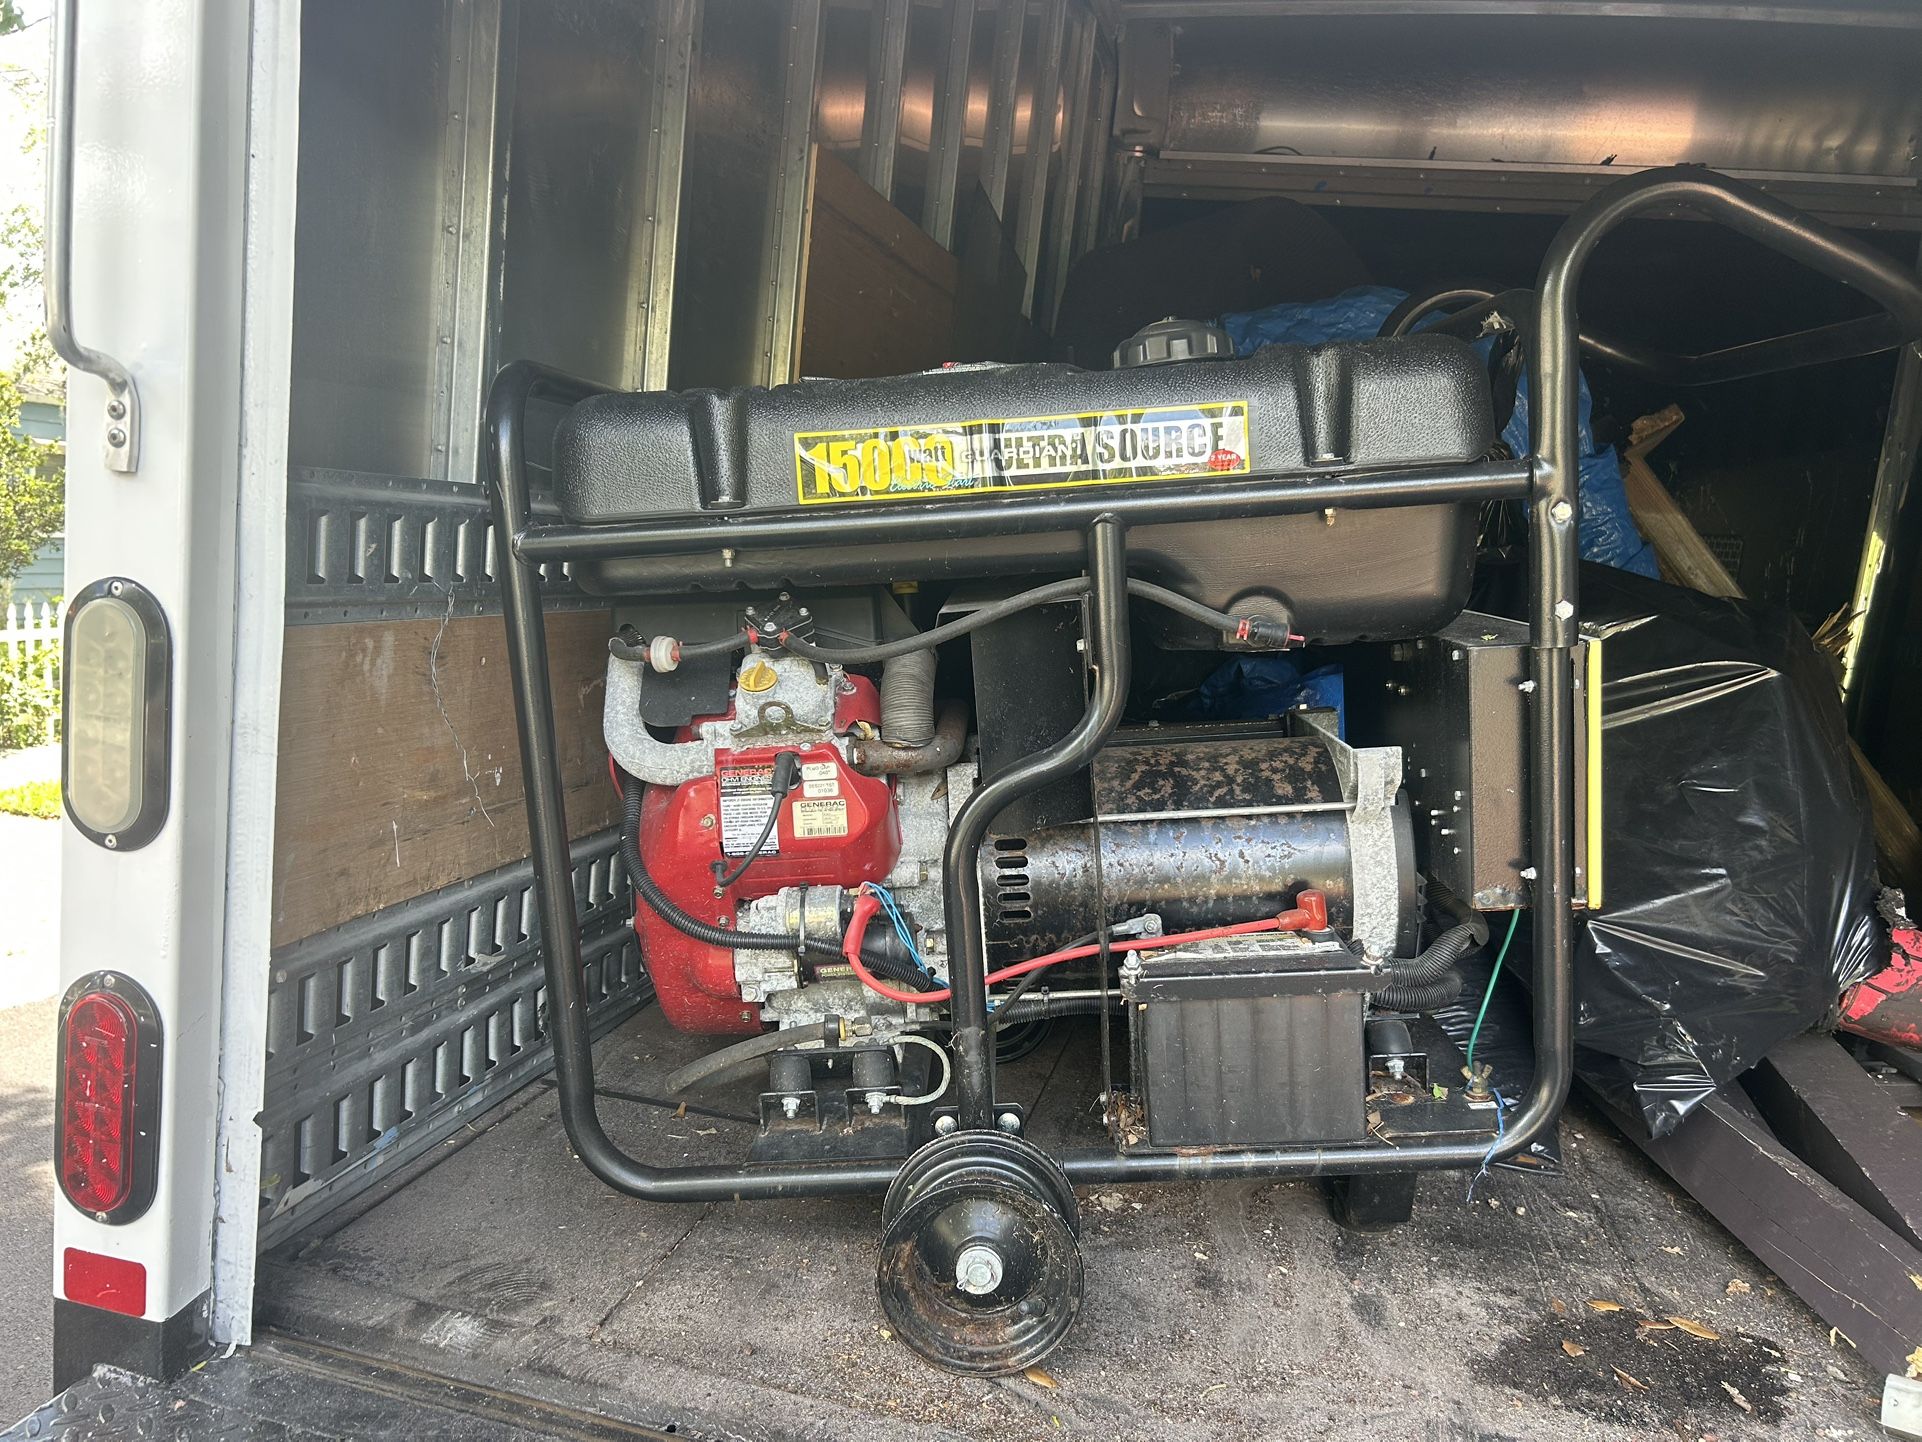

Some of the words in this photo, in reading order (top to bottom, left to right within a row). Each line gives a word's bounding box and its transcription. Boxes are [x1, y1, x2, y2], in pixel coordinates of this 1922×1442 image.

[1096, 422, 1224, 463] SOURCE
[803, 434, 954, 494] 15000
[1217, 453, 1238, 461] YEAR
[800, 801, 845, 809] GENERAC
